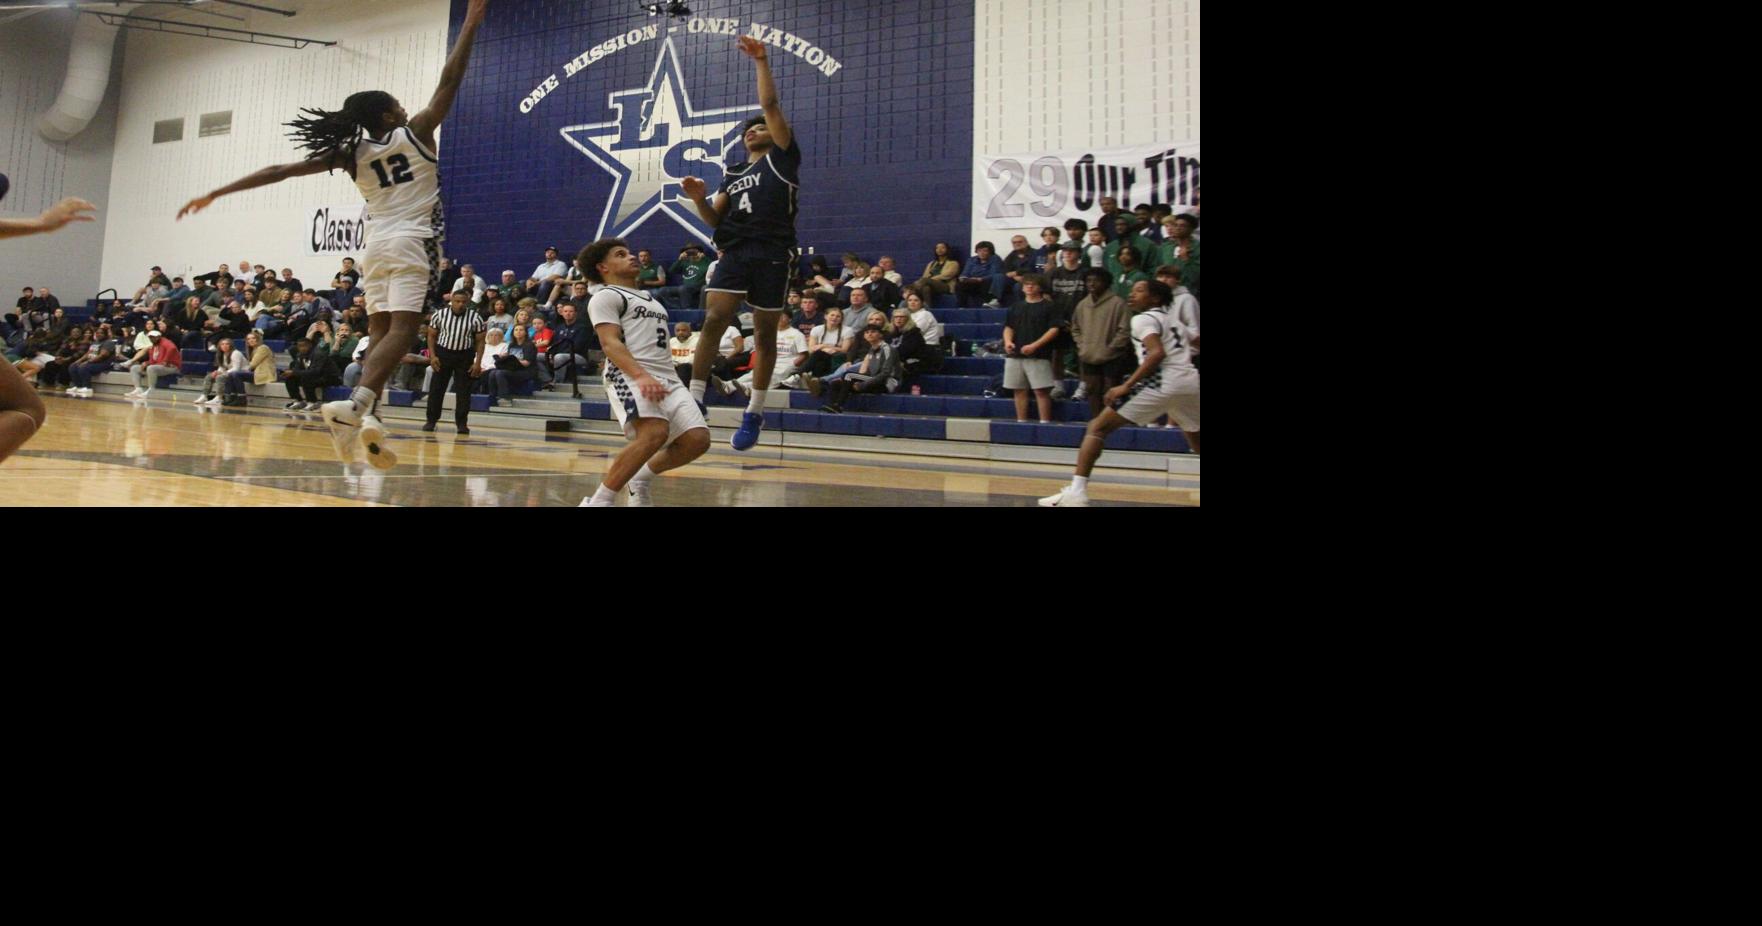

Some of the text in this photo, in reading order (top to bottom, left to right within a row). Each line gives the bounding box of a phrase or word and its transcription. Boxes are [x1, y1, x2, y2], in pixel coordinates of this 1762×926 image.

[520, 74, 560, 114] ONE
[563, 24, 659, 78] MISSION
[687, 17, 740, 35] ONE
[748, 22, 843, 77] NATION
[369, 152, 415, 189] 12
[985, 155, 1070, 219] 29
[1073, 153, 1136, 212] Our
[738, 191, 753, 214] 4
[312, 207, 367, 253] Class o
[656, 327, 667, 349] 2
